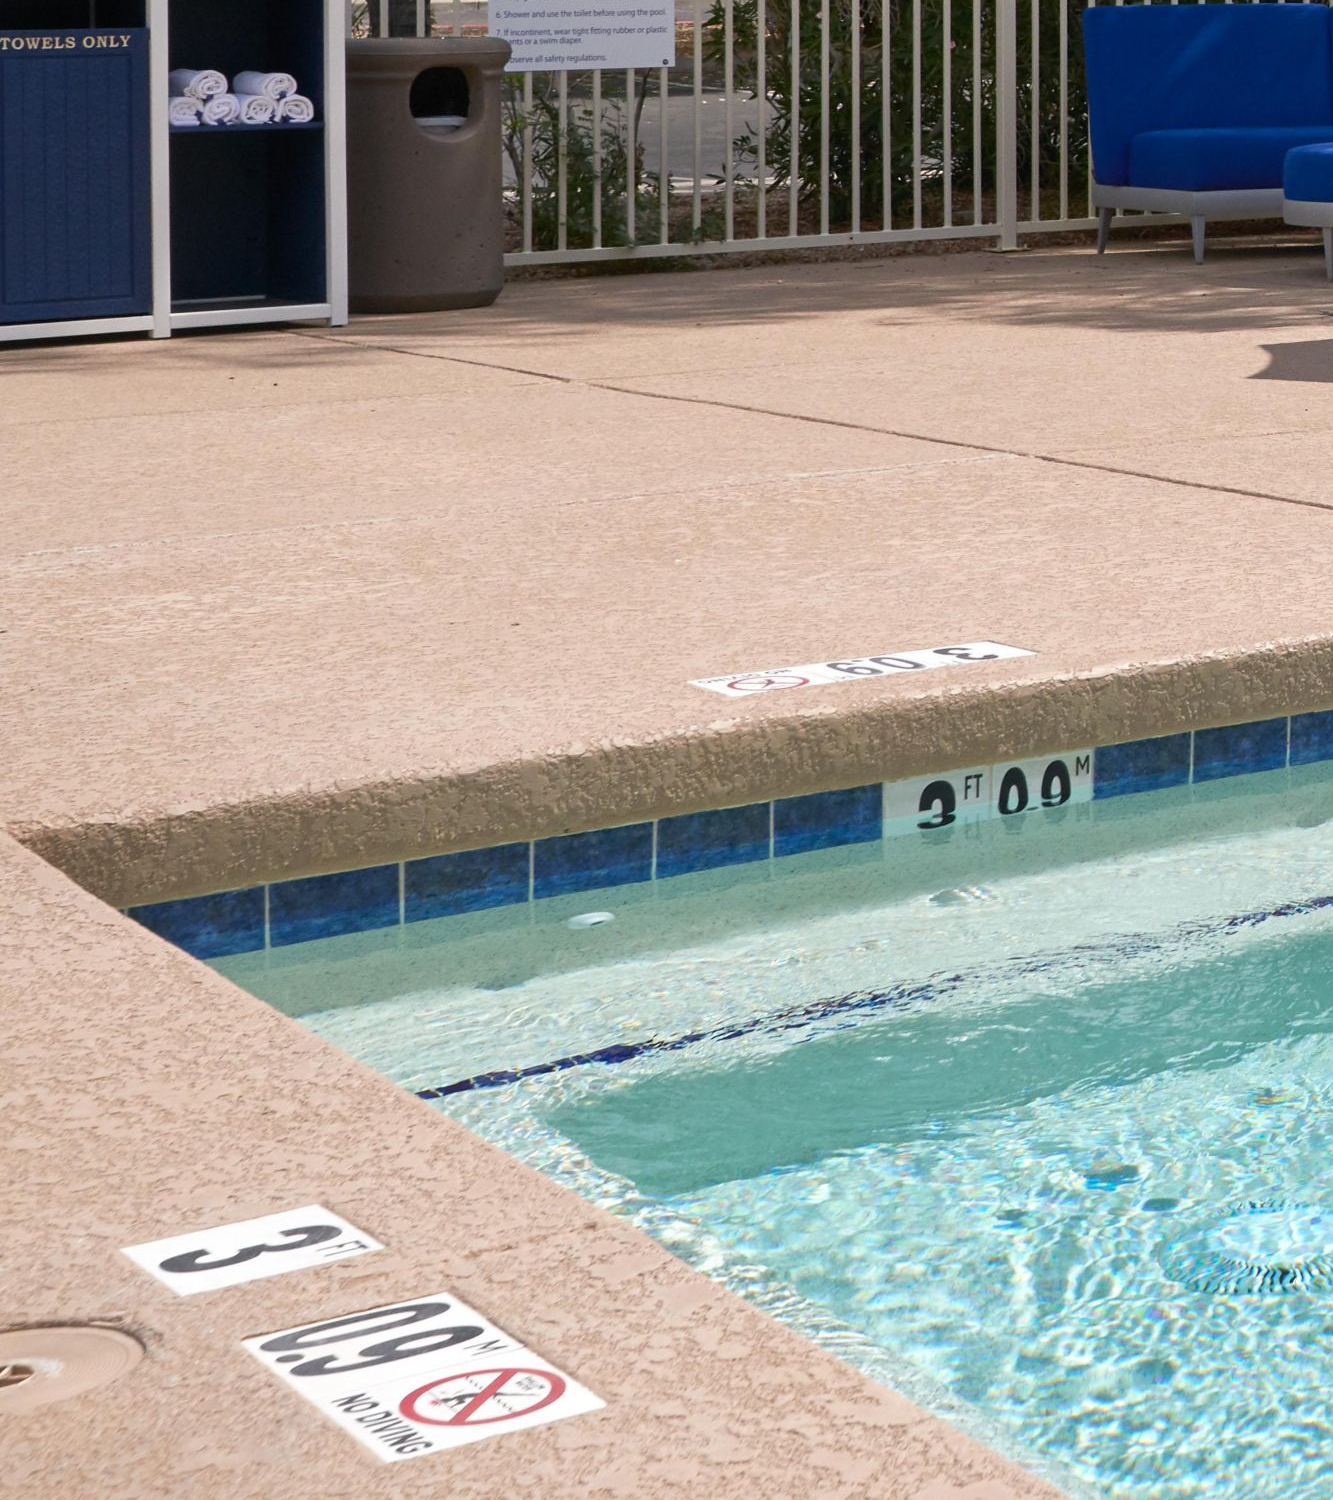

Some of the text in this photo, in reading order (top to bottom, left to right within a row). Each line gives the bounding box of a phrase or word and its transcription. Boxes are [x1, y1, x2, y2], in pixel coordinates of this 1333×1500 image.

[503, 10, 530, 18] Shower
[531, 10, 546, 18] and
[573, 9, 592, 17] toilet
[593, 9, 616, 17] before
[617, 9, 636, 18] using
[637, 8, 648, 16] the
[590, 26, 612, 36] fitting
[645, 25, 668, 35] plastic
[0, 35, 131, 50] TOWELS ONLY
[544, 54, 565, 64] safety
[933, 647, 999, 660] 3
[918, 780, 956, 829] 3
[964, 773, 983, 799] FT
[1075, 754, 1090, 776] M
[159, 1224, 370, 1273] 3 FT
[461, 1339, 501, 1357] M
[331, 1392, 434, 1454] NO DIVING
